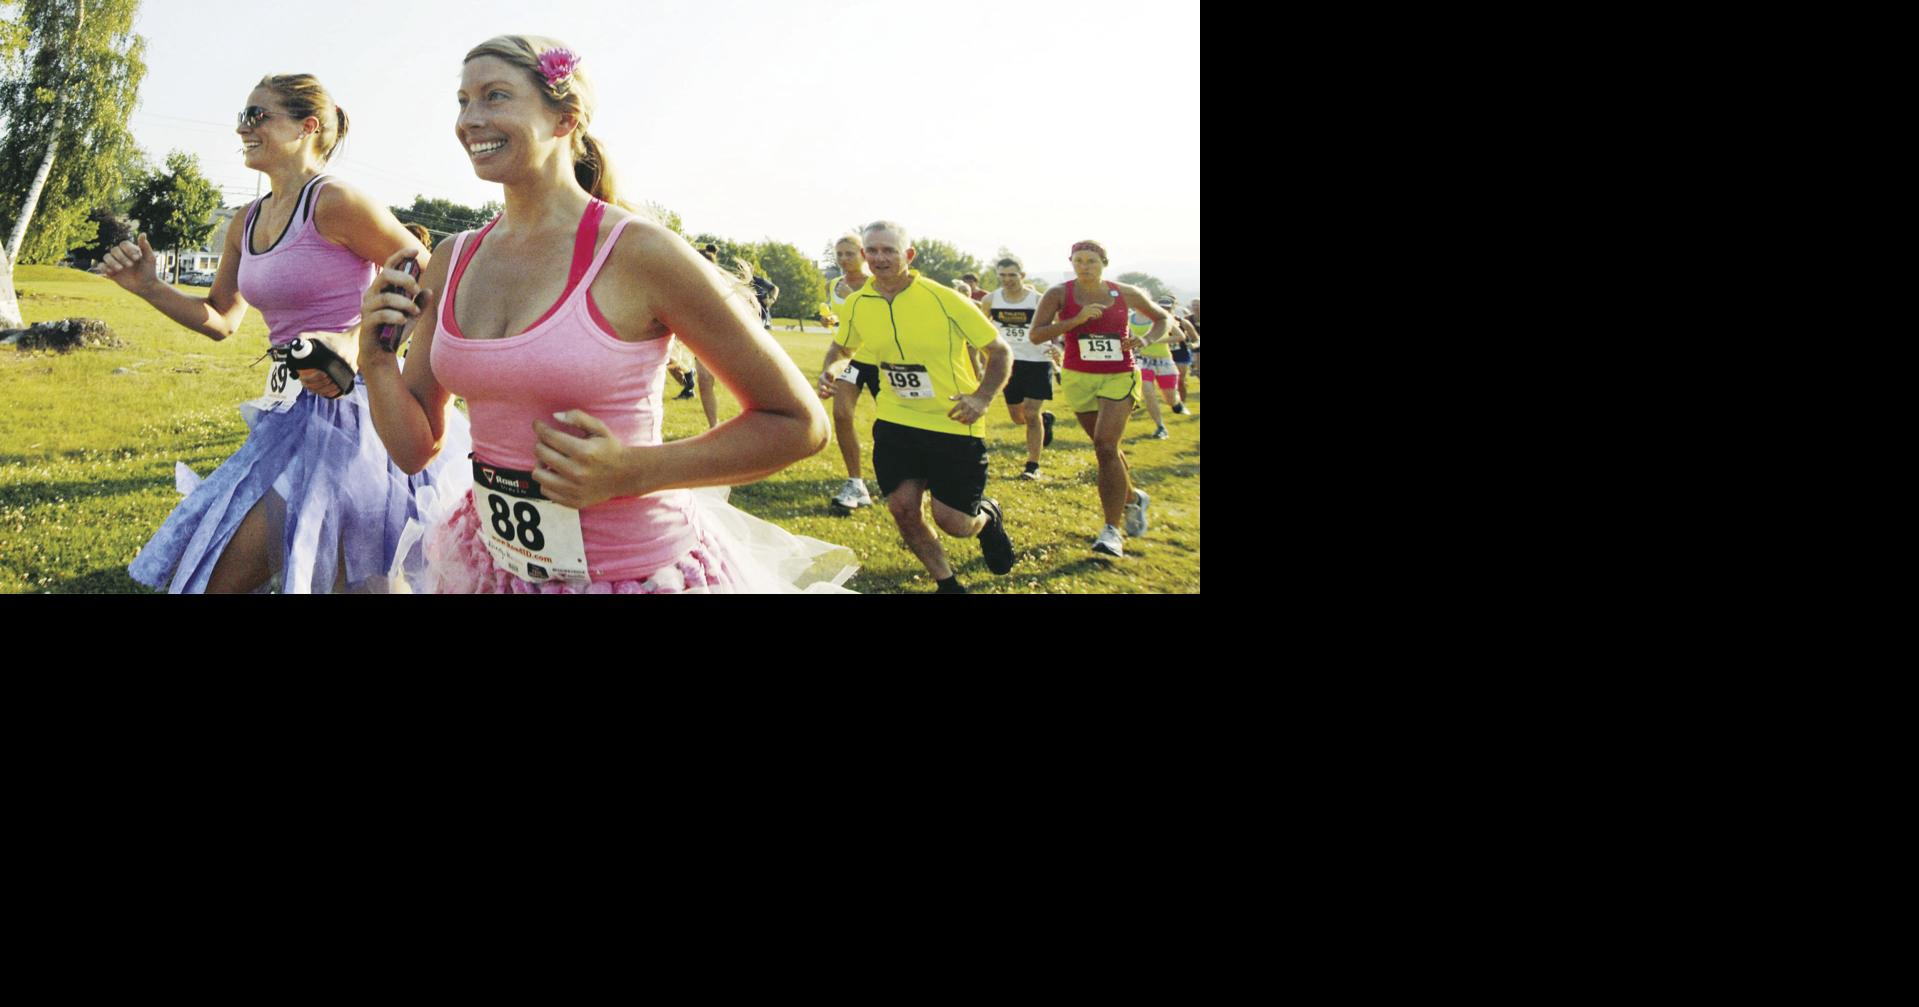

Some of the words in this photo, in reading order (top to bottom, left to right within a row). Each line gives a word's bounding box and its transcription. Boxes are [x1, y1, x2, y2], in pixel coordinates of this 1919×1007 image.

[1005, 328, 1025, 337] 269
[1088, 340, 1113, 352] 151
[887, 372, 921, 388] 198
[488, 494, 545, 551] 88
